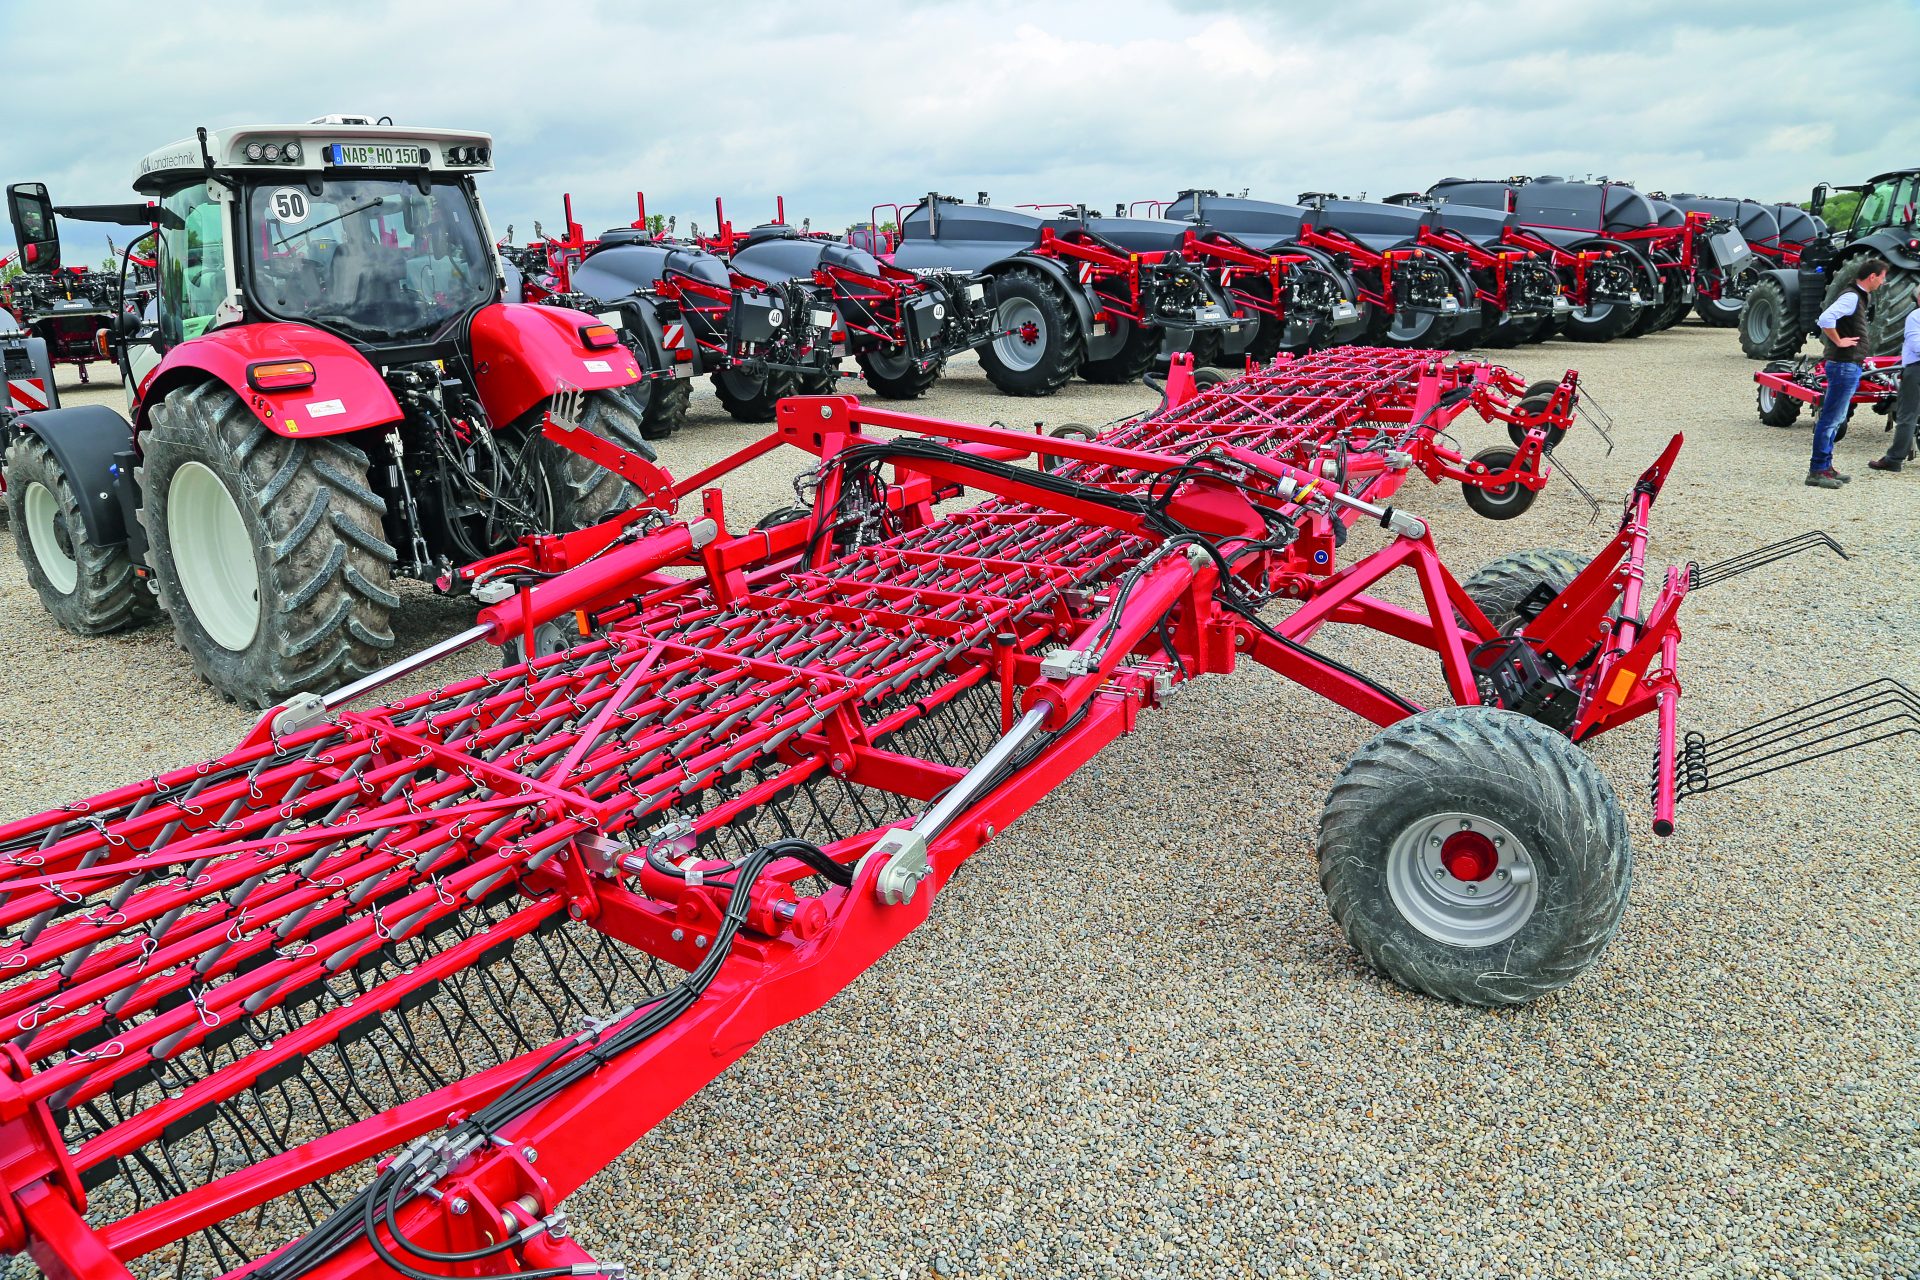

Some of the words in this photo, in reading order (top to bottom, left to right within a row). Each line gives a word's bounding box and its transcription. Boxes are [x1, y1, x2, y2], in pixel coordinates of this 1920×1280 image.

[152, 152, 195, 171] Landtechnik
[342, 147, 367, 163] NAB
[376, 148, 392, 164] HO
[395, 148, 418, 164] 150
[275, 193, 305, 218] 50
[770, 312, 780, 323] 40
[936, 306, 943, 316] 40
